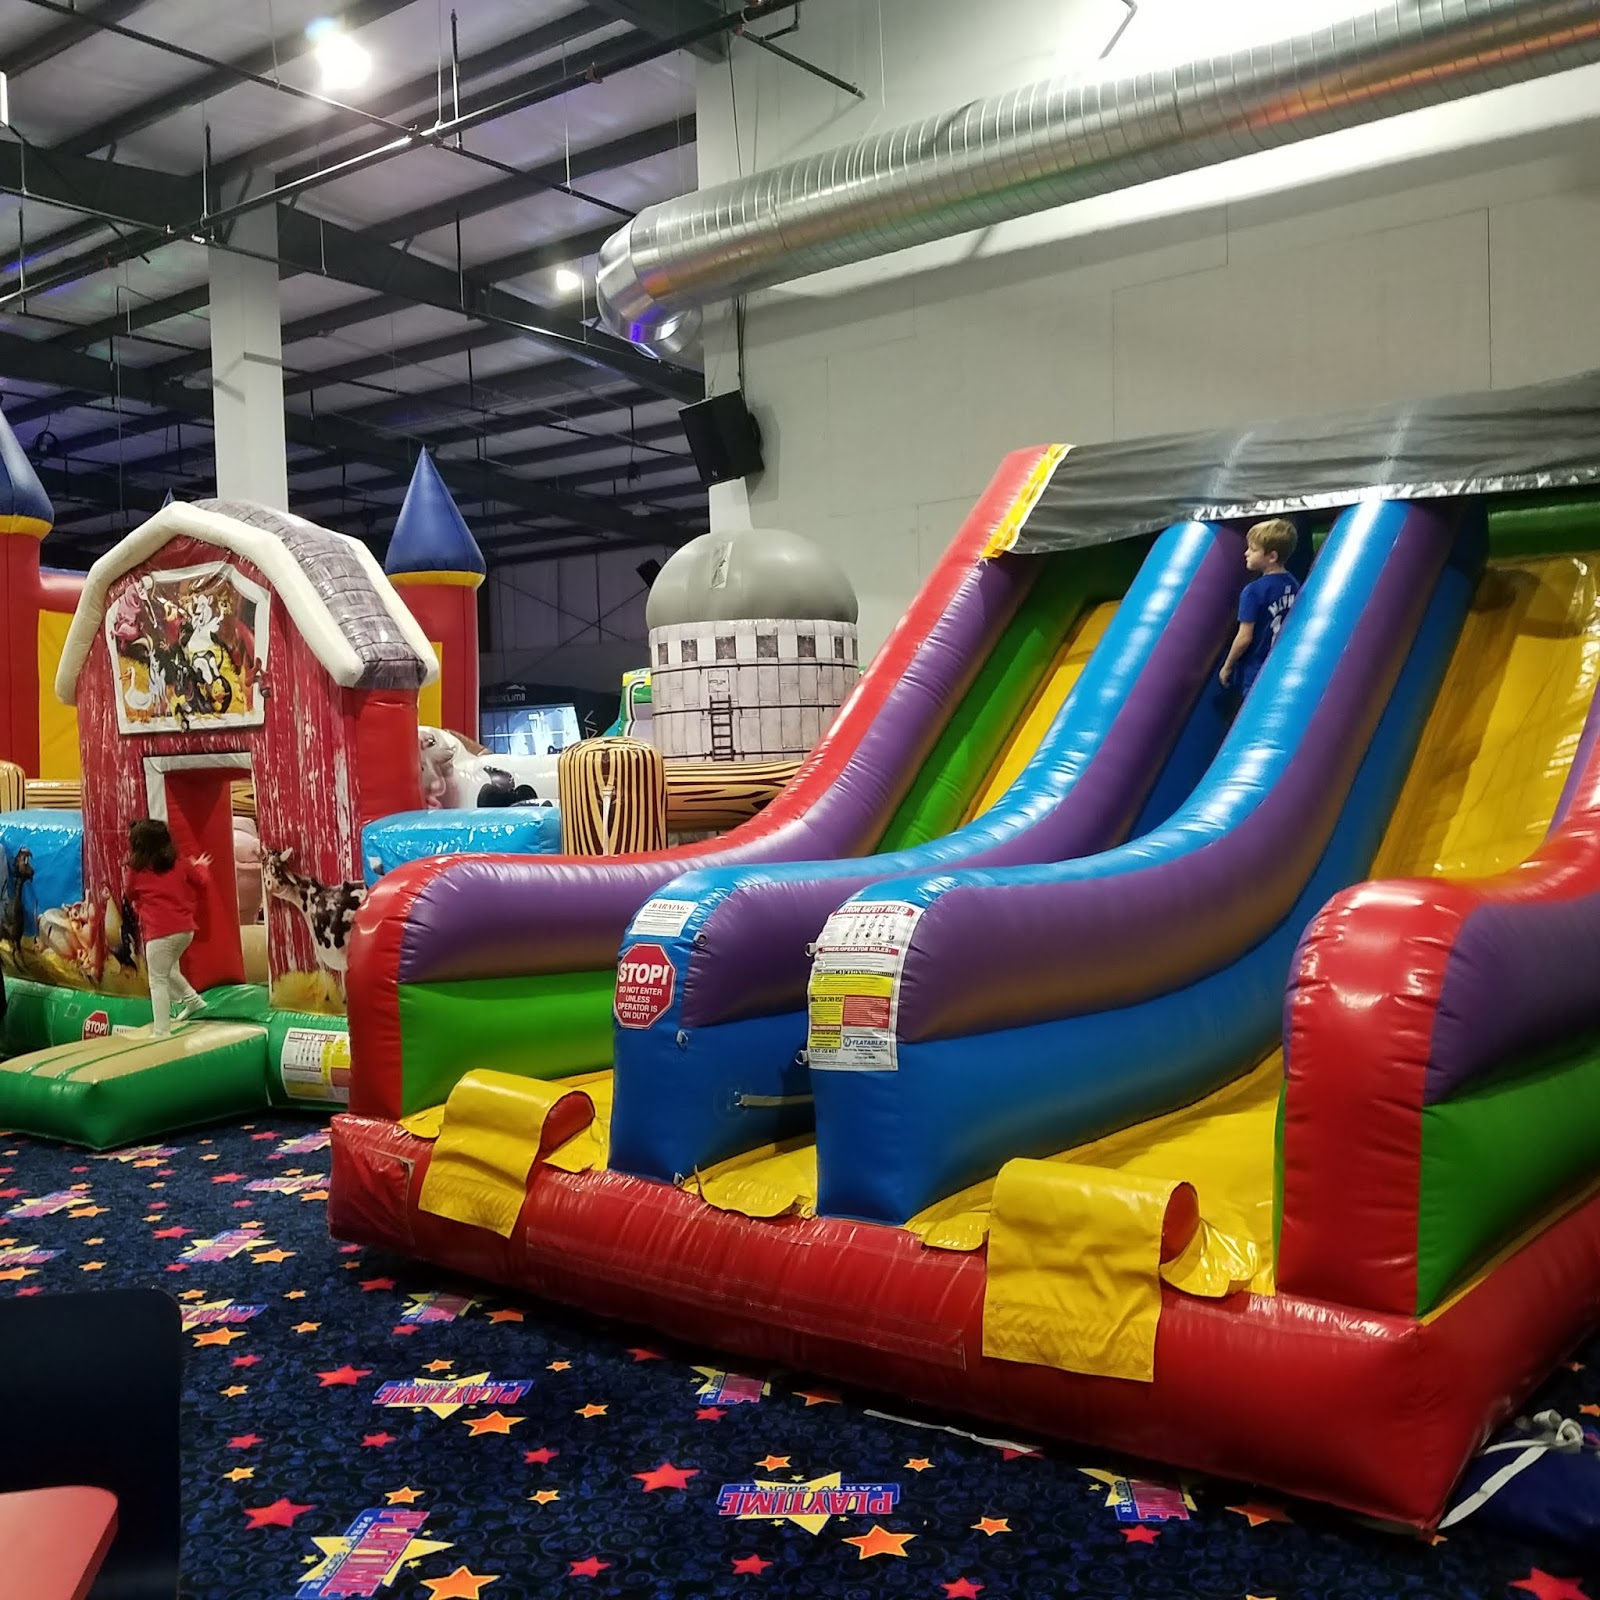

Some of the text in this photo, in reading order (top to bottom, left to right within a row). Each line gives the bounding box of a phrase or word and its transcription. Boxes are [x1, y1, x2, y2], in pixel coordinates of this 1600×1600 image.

[861, 905, 885, 914] SAFETY
[885, 905, 909, 915] RULES
[619, 962, 670, 985] STOP!
[619, 985, 662, 996] DO NOT ENTER
[625, 994, 650, 1003] UNLESS
[617, 1002, 650, 1012] OPERATOR
[622, 1011, 650, 1020] ON DUTY
[372, 1386, 526, 1405] PLAYTIME
[821, 1485, 883, 1493] PARTY
[718, 1491, 894, 1516] PLAYTIME
